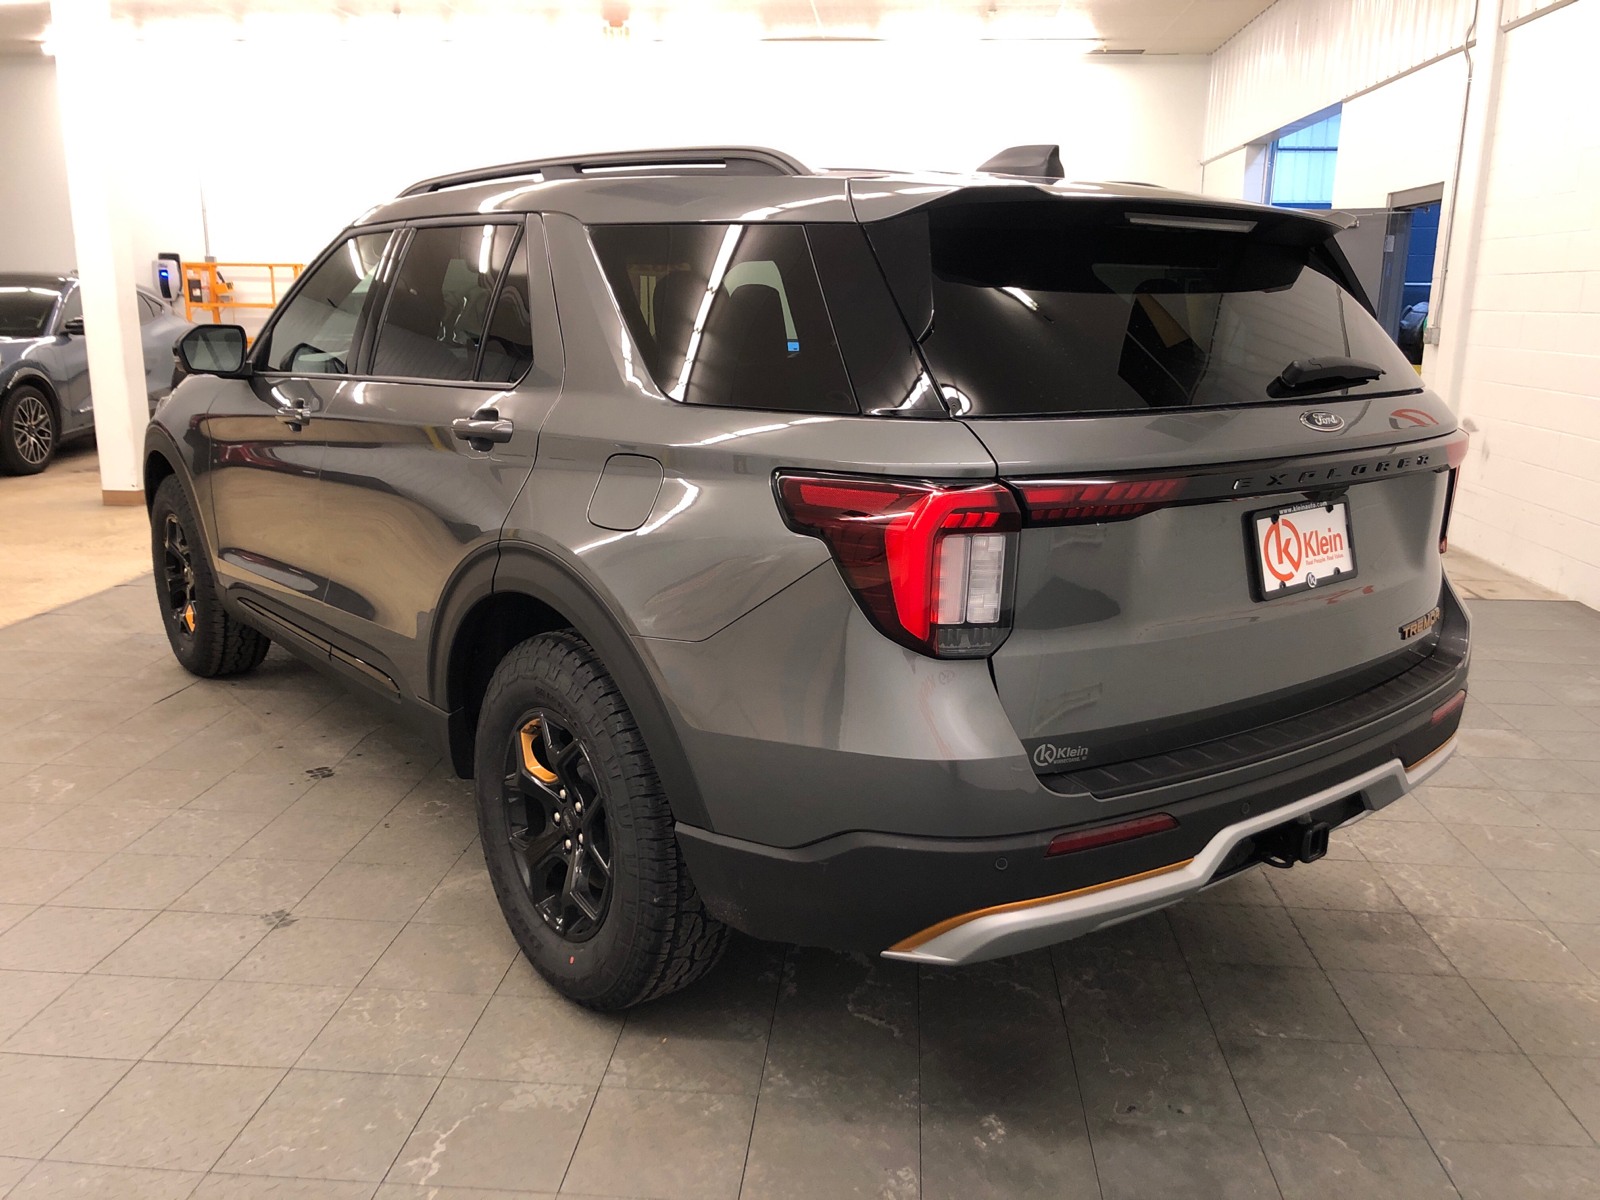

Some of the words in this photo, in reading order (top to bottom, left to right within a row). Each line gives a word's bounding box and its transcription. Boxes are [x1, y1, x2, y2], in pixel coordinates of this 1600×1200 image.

[1313, 413, 1337, 425] Ford
[1232, 455, 1428, 490] EXPLORER
[1279, 502, 1327, 514] www.kleinauto.com
[1303, 528, 1343, 558] Klein
[1398, 606, 1440, 640] TREMOR
[1057, 746, 1088, 758] Klein
